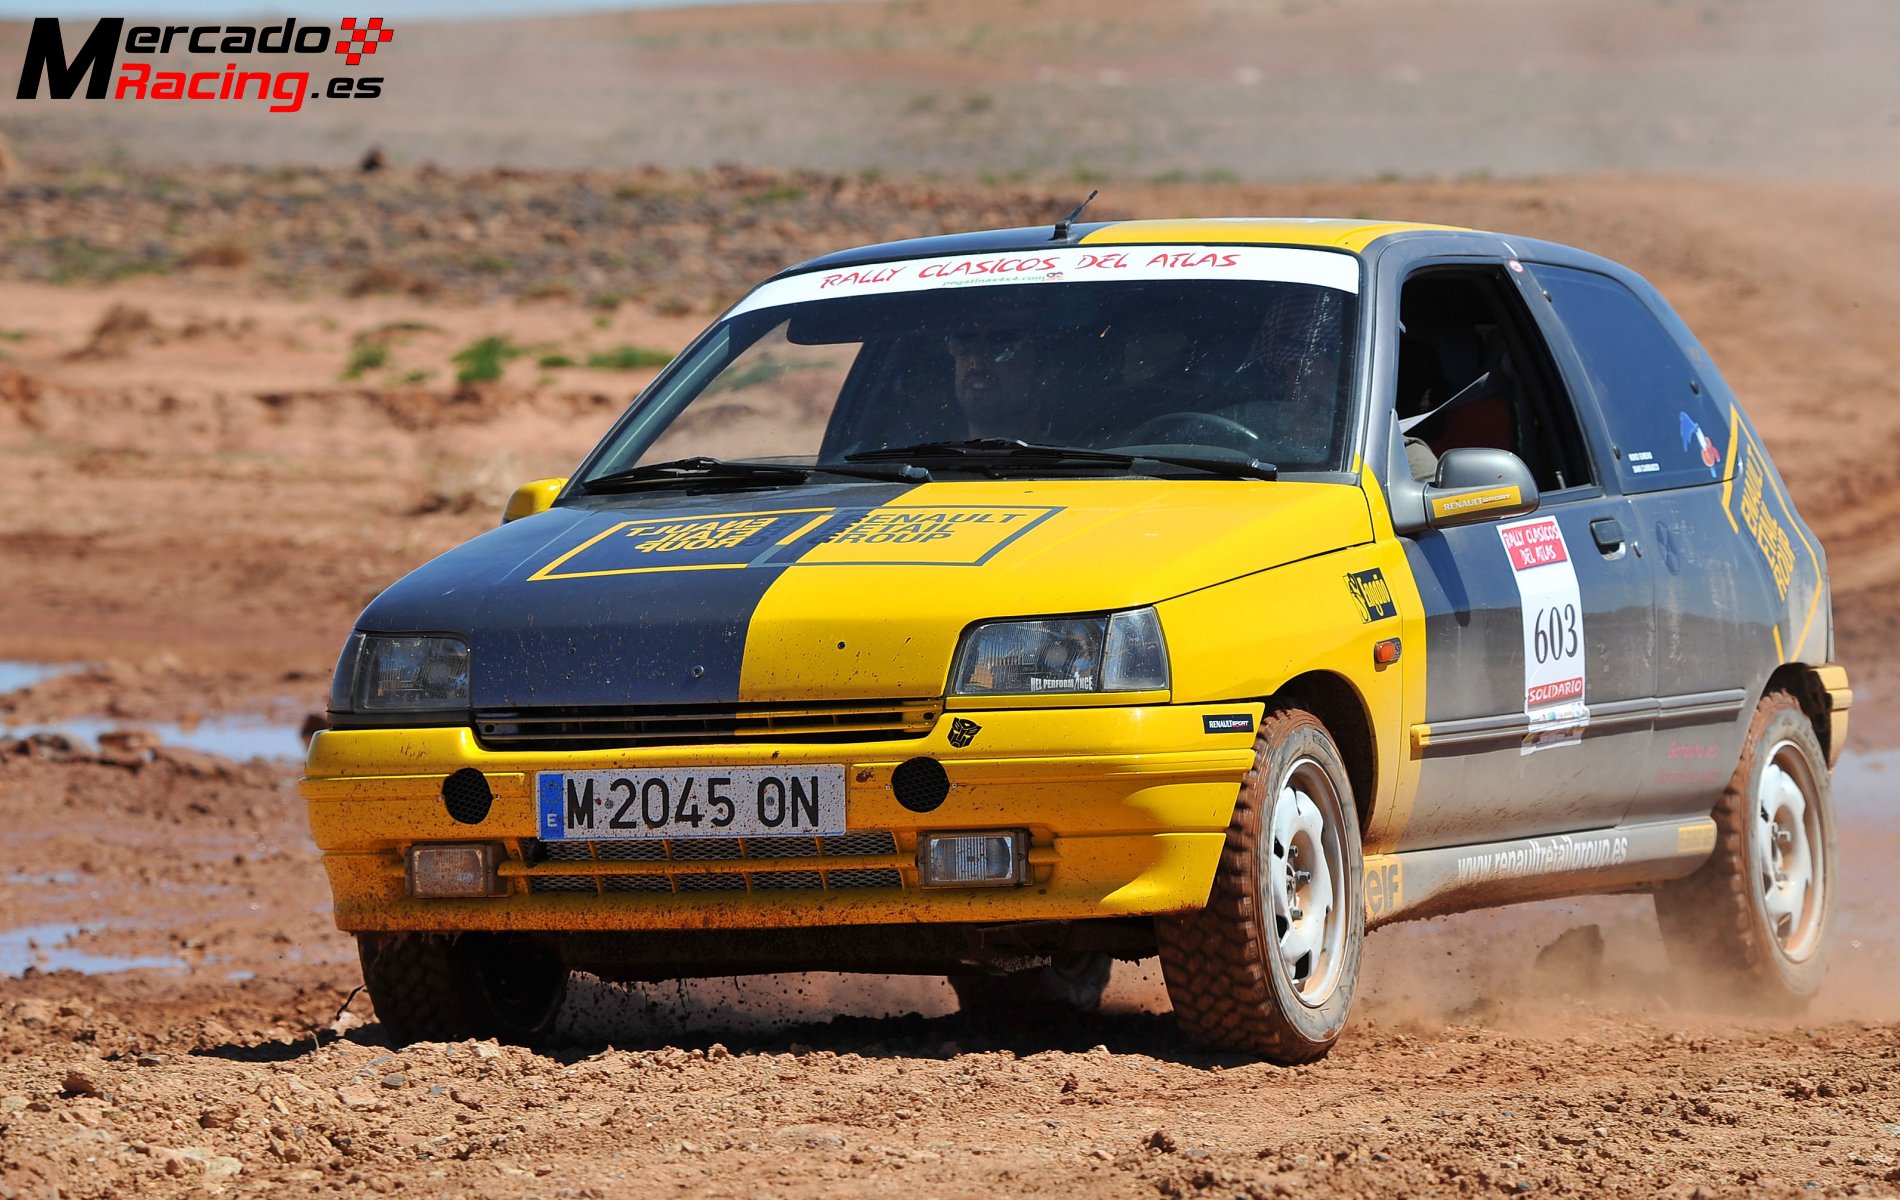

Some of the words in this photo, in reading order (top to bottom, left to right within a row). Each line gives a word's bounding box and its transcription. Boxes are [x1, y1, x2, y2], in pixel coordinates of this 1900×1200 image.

[820, 266, 907, 289] RALLY
[918, 257, 1061, 279] CLASICOS
[1074, 253, 1129, 269] DEL
[1145, 253, 1242, 268] ATLAS
[1503, 530, 1525, 549] RALLY
[1519, 547, 1537, 565] DEL
[1535, 544, 1557, 562] ATLAS
[1534, 603, 1578, 664] 603
[1030, 677, 1042, 692] HEL
[1529, 680, 1582, 704] SOLIDARIO
[567, 778, 594, 830] M
[609, 776, 736, 830] 2045
[547, 813, 558, 828] E
[1366, 863, 1399, 914] elf
